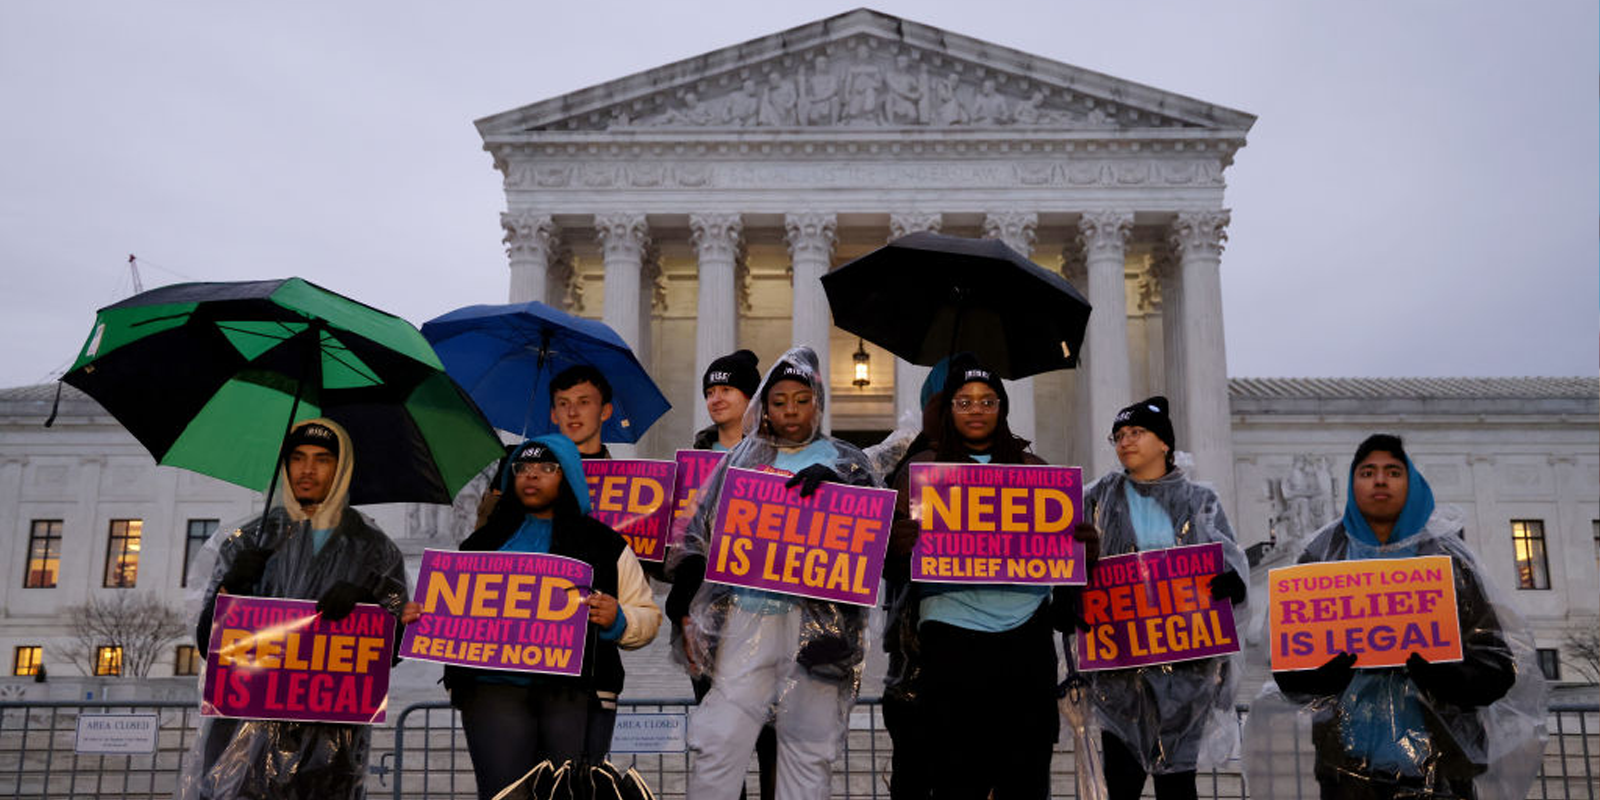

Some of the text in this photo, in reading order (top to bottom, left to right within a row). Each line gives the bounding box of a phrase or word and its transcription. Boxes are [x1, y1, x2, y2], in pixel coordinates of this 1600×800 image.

[612, 463, 667, 476] FAMILIES
[944, 468, 1003, 485] MILLION
[1008, 470, 1073, 487] FAMILIES
[829, 491, 884, 519] LOAN
[921, 486, 1074, 532] NEED
[724, 498, 882, 553] RELIEF
[921, 533, 1073, 556] STUDENT LOAN
[430, 554, 584, 578] 40 MILLION FAMILIES
[716, 535, 870, 594] IS LEGAL
[921, 557, 1074, 578] RELIEF NOW
[1088, 552, 1215, 590] TUDENT LOAN
[1277, 568, 1442, 593] STUDENT LOAN
[424, 571, 581, 621] NEED
[1081, 573, 1217, 624] RELIEF
[1279, 589, 1443, 625] RELIEF
[417, 615, 574, 647] STUDENT LOAN
[1086, 610, 1231, 661] IS LEGAL
[1280, 621, 1450, 657] IS LEGAL
[218, 628, 385, 673] RELIEF
[411, 635, 573, 668] RELIEF NOW
[213, 668, 380, 714] IS LEGAL
[87, 721, 149, 730] AREA CLOSED
[617, 720, 678, 729] AREA CLOSED
